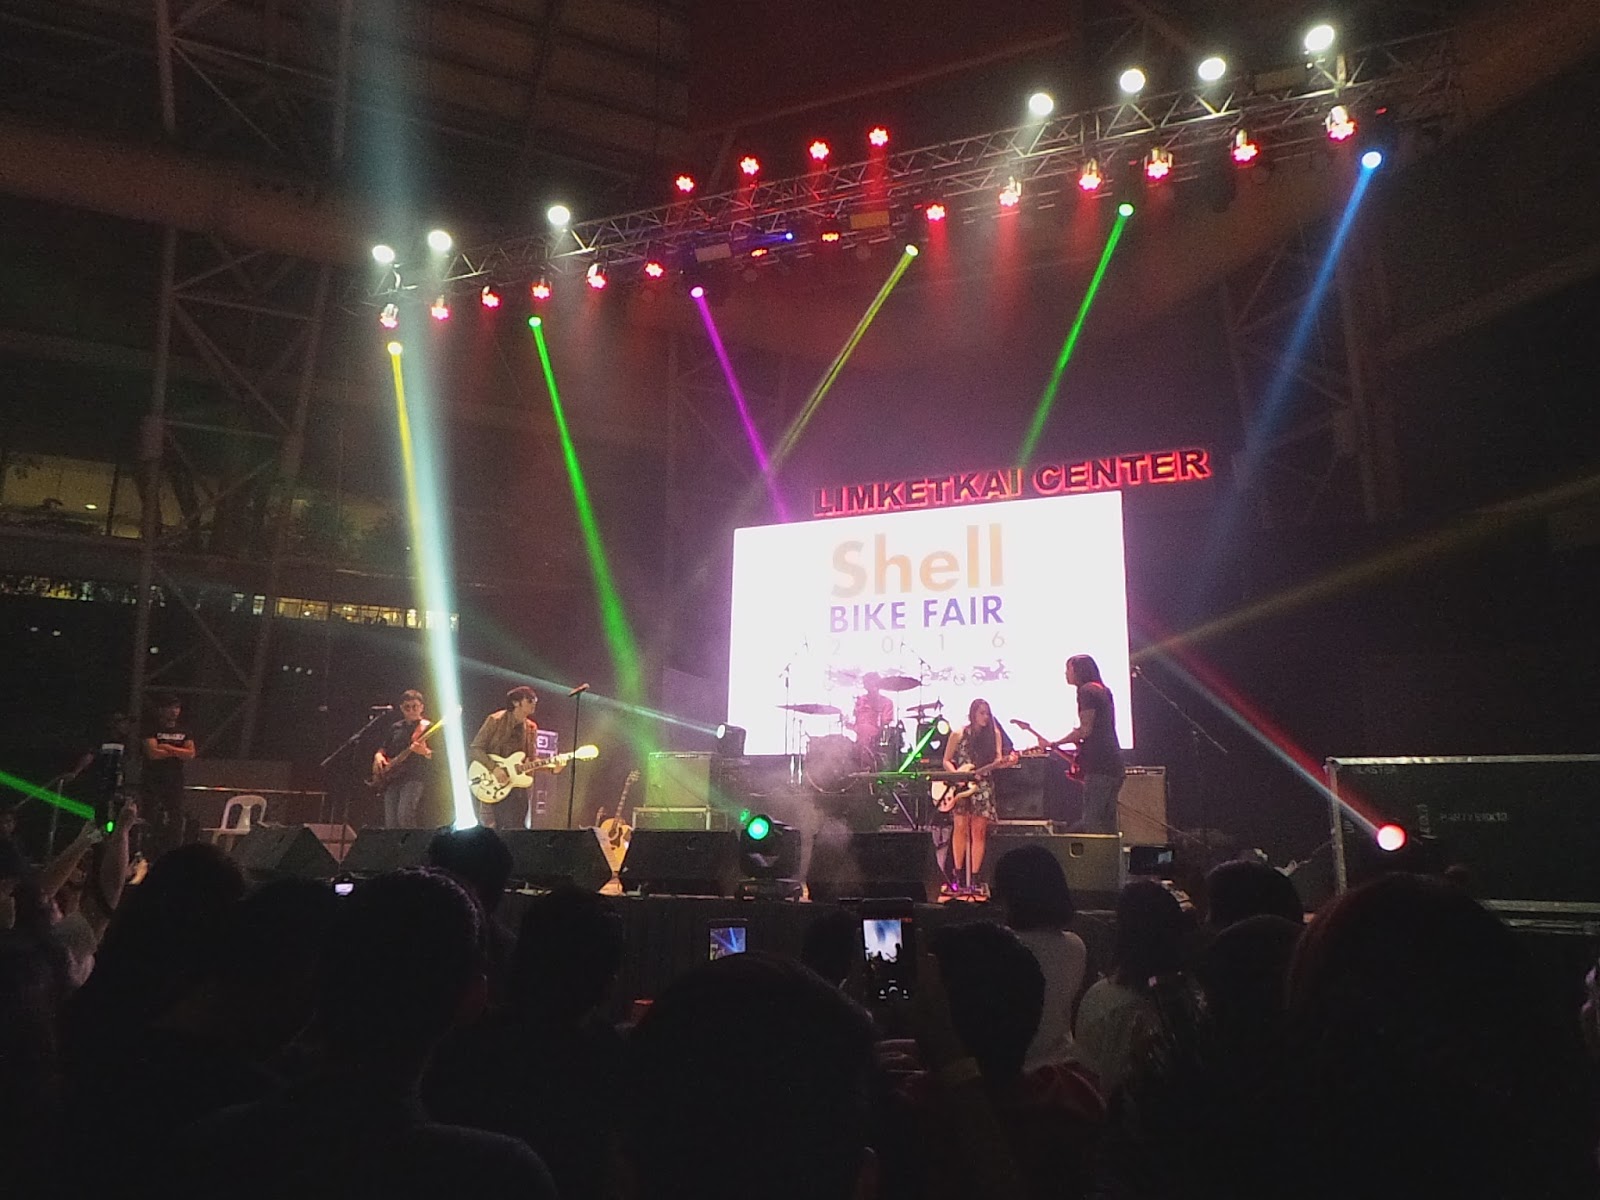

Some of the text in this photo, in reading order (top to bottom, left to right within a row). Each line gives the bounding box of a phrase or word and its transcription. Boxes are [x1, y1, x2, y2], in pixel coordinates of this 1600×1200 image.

[813, 448, 1212, 517] LIMKETKAI CENTER
[831, 522, 1004, 599] Shell
[829, 595, 1005, 633] BIKE FAIR
